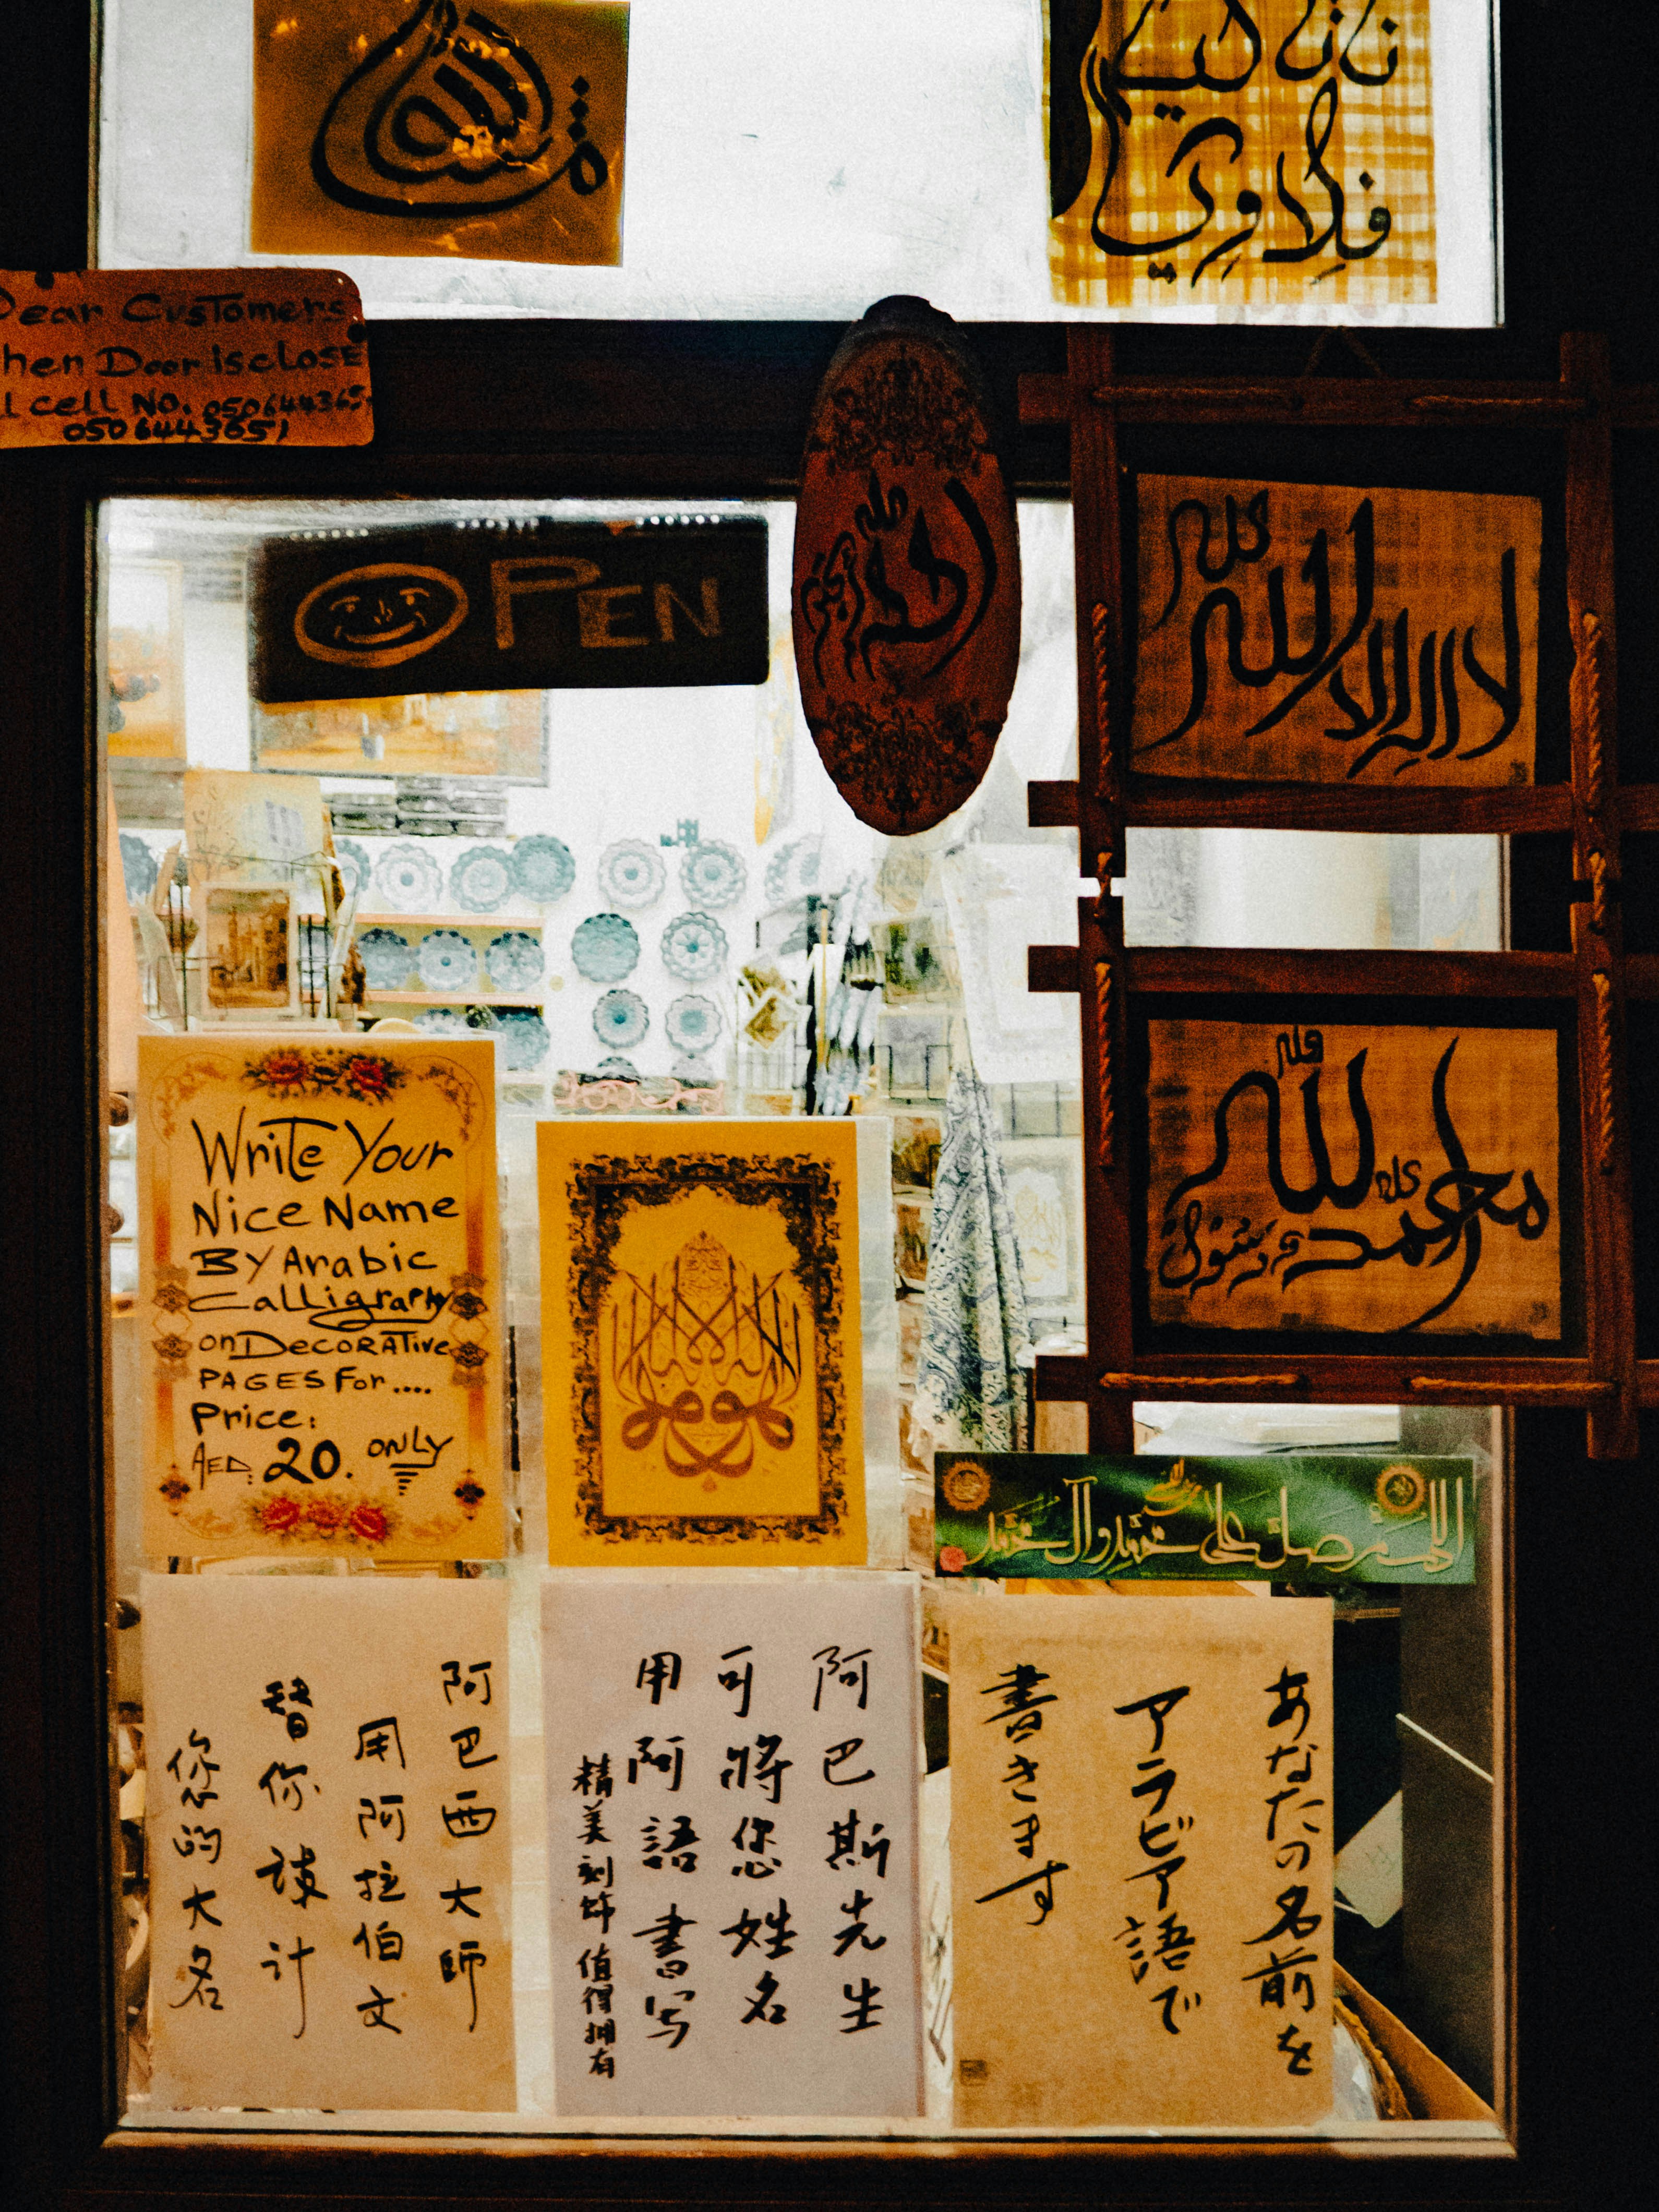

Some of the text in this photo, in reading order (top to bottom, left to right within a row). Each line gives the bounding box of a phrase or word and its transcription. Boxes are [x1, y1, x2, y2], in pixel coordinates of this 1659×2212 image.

[96, 345, 201, 378] Door
[30, 388, 119, 416] cell
[343, 1117, 453, 1186] Your
[192, 1188, 460, 1238] Nice Name
[283, 1241, 438, 1279] Arabic
[199, 1368, 325, 1391] PAGES
[191, 1402, 316, 1436] Price:
[974, 1663, 1070, 1926] 書きます
[812, 1644, 893, 2035] 阿巴斯先生
[1113, 1685, 1201, 2035] アラビア語で
[1242, 1665, 1326, 2076] あなたの名前を
